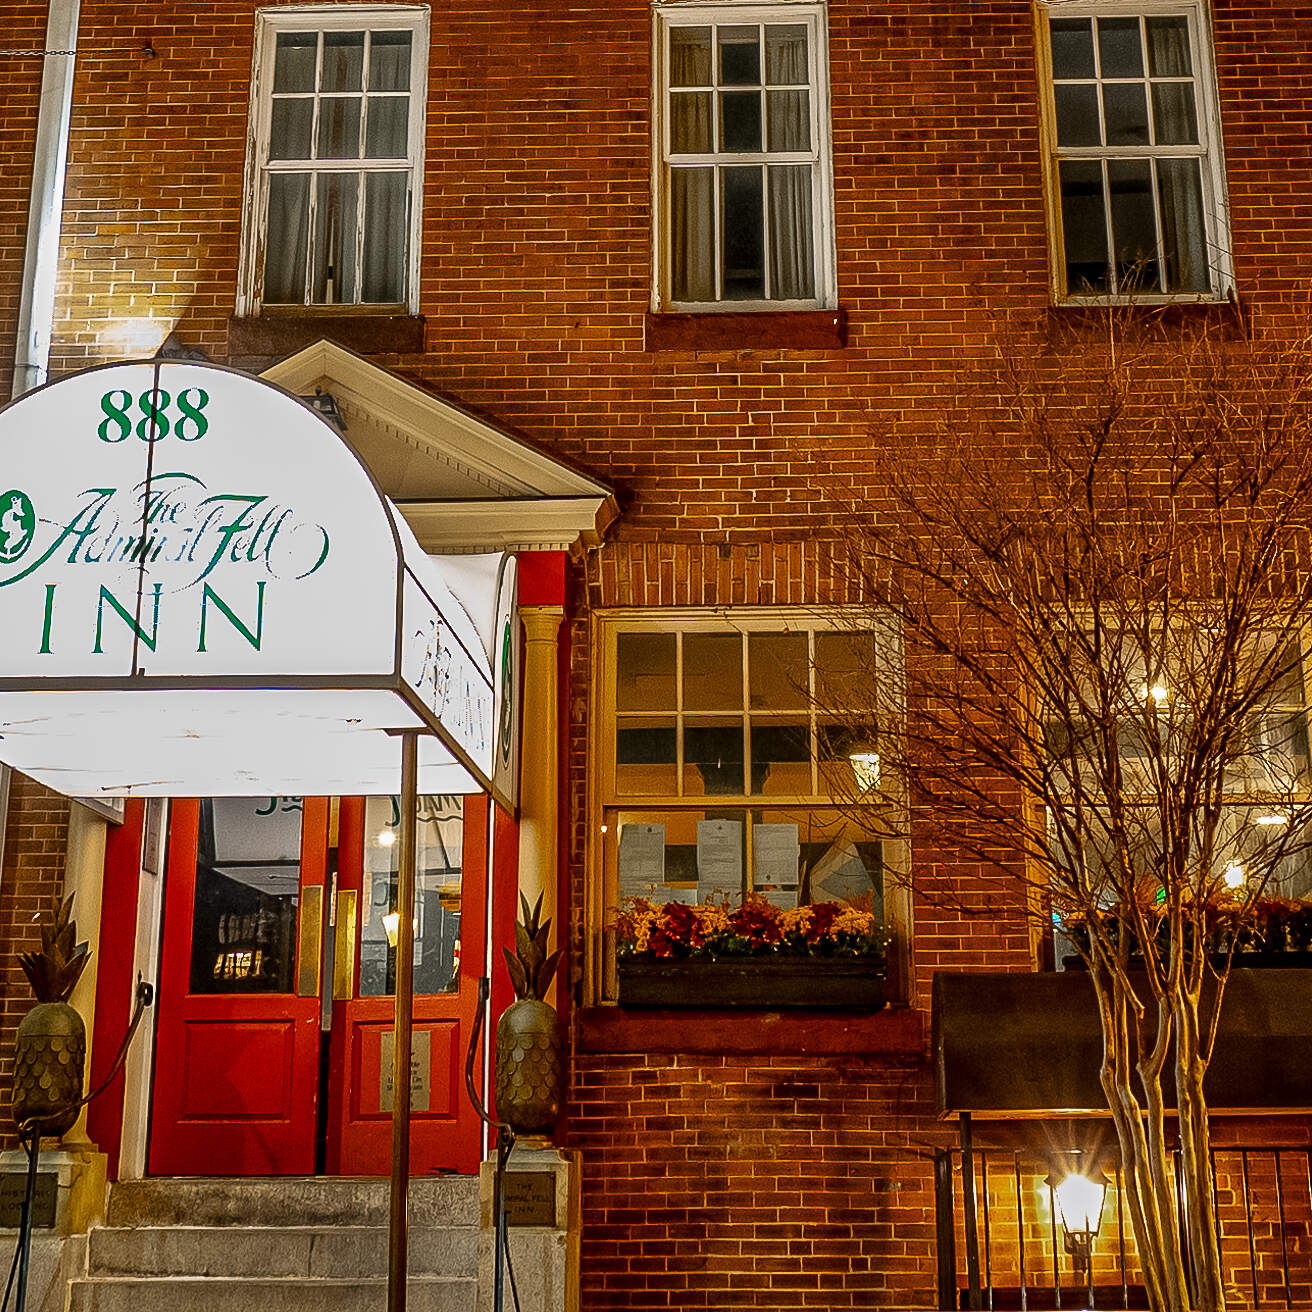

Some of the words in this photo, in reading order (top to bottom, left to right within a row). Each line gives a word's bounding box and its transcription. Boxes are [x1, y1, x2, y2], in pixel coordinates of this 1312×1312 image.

[96, 386, 209, 443] 888
[133, 472, 207, 525] The
[188, 494, 329, 582] Fell
[37, 580, 267, 655] INN
